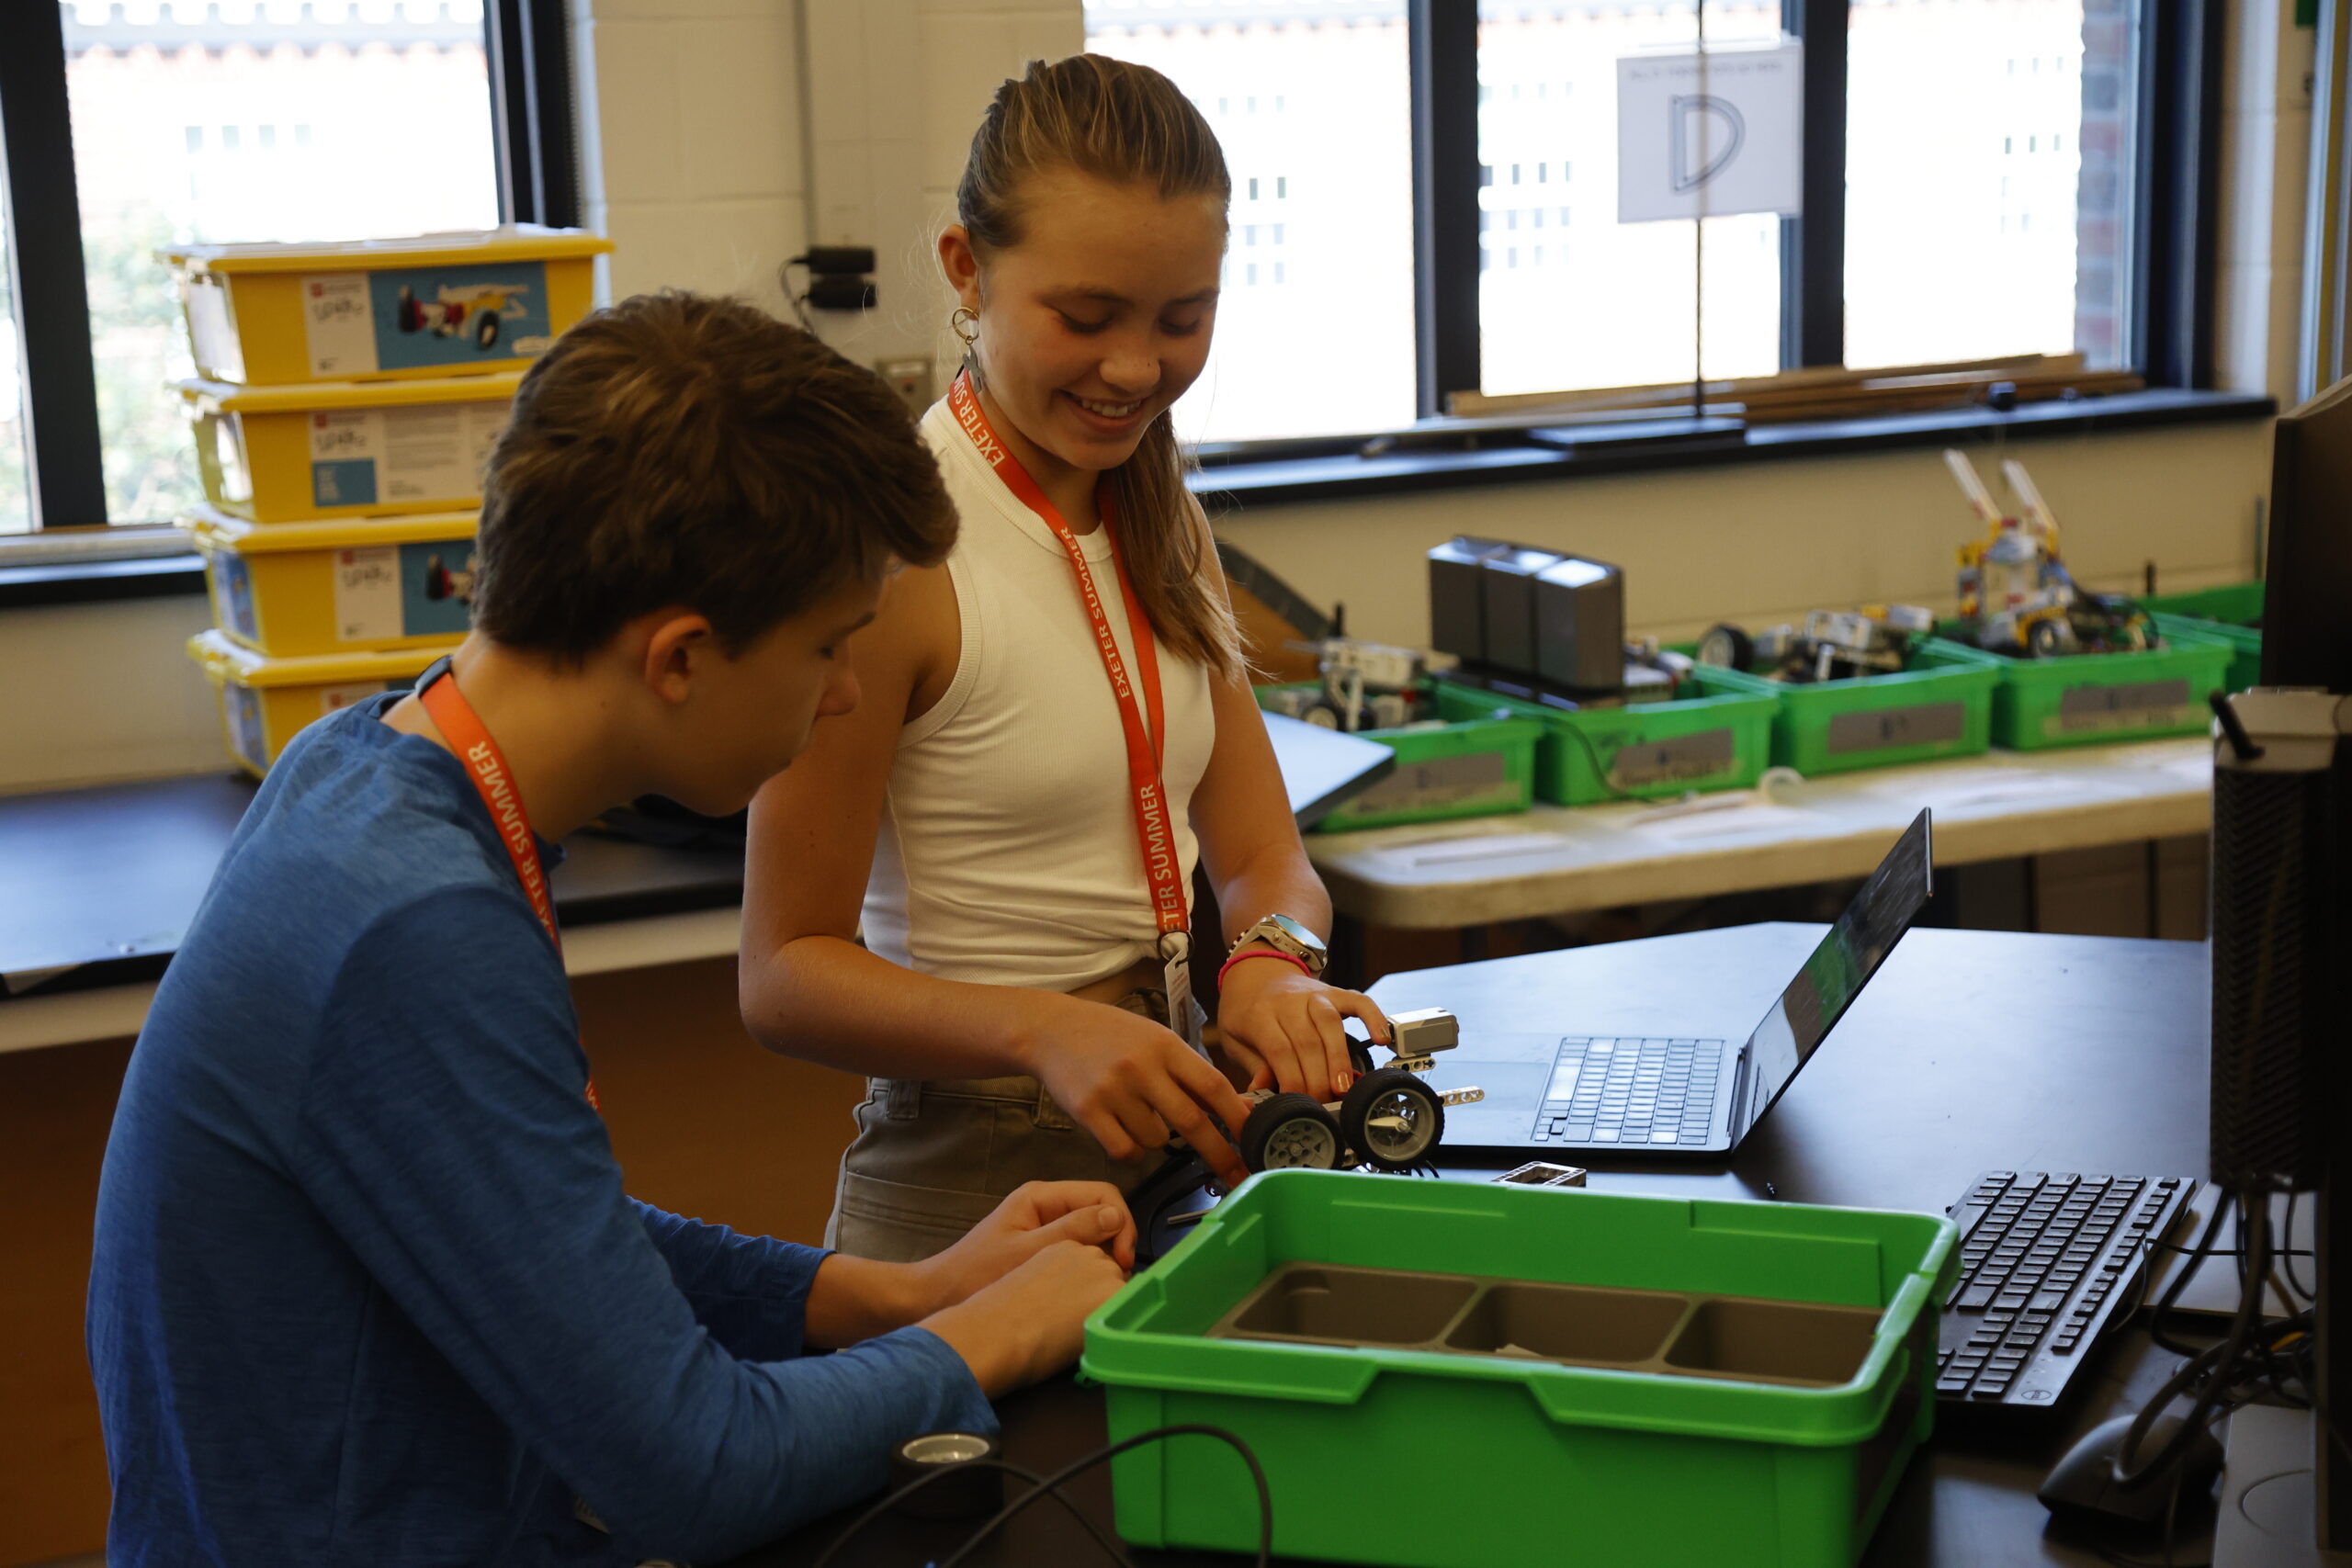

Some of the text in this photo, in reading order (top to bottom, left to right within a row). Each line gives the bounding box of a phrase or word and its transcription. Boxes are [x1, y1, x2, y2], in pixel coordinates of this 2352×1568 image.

[1668, 94, 1746, 196] D
[959, 400, 1005, 467] EXETER
[1060, 526, 1130, 699] EXETER SUMMER
[468, 740, 555, 938] XETER SUMMER
[1140, 784, 1181, 932] ETER SUMMER
